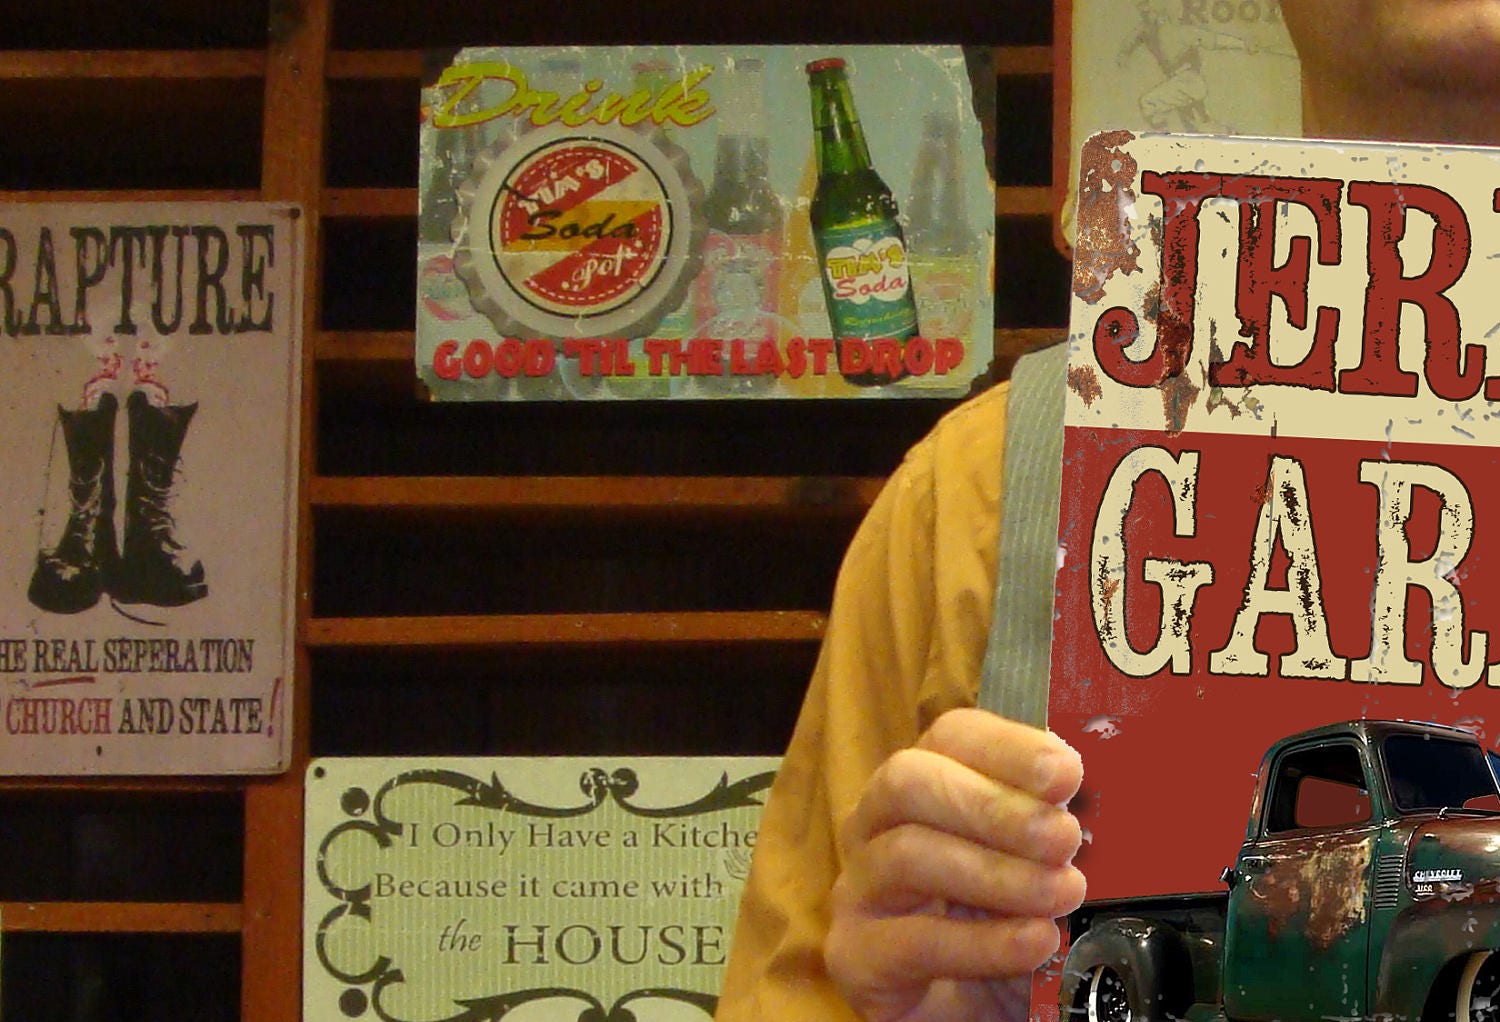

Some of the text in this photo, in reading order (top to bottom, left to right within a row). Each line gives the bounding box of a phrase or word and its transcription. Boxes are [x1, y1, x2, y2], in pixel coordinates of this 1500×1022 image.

[430, 62, 717, 130] Drink
[519, 209, 638, 241] Soda
[835, 273, 907, 298] Soda
[432, 338, 555, 381] GOOD
[642, 338, 724, 379] THE
[730, 337, 834, 379] LAST
[839, 336, 966, 380] DROP
[0, 637, 255, 673] HE REAL SEPERATION
[6, 697, 113, 735] CHURCH
[118, 697, 175, 735] AND
[408, 822, 420, 848] I
[432, 821, 516, 856] Only
[528, 822, 611, 848] Have
[622, 829, 639, 848] a
[374, 872, 724, 899] Because it came with
[437, 918, 727, 966] the HOUSE
